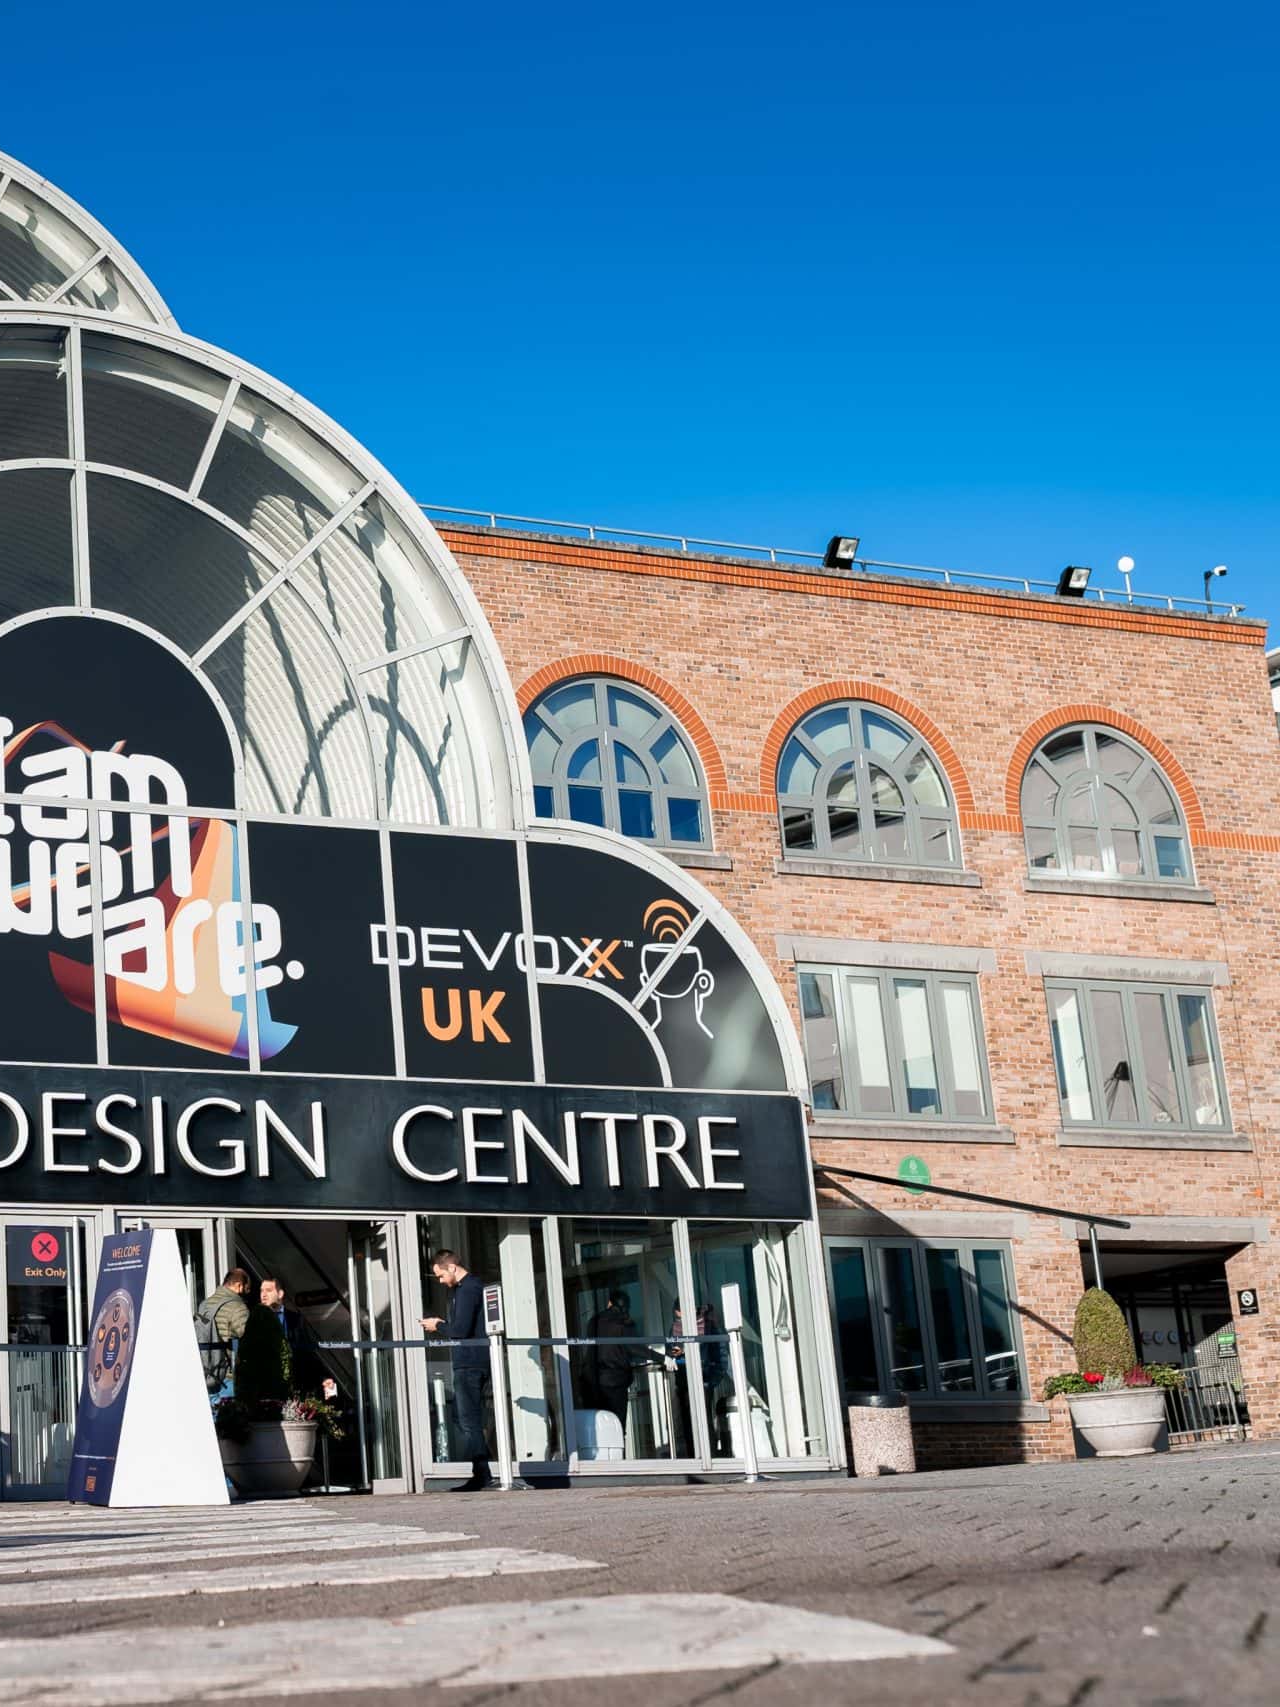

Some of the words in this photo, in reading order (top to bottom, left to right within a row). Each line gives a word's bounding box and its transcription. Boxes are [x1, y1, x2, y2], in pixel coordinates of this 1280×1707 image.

[21, 746, 193, 898] am
[370, 923, 625, 980] DEVOXX
[422, 987, 511, 1044] UK
[392, 1104, 745, 1190] CENTRE
[25, 1267, 44, 1277] Exit
[45, 1267, 66, 1279] Only
